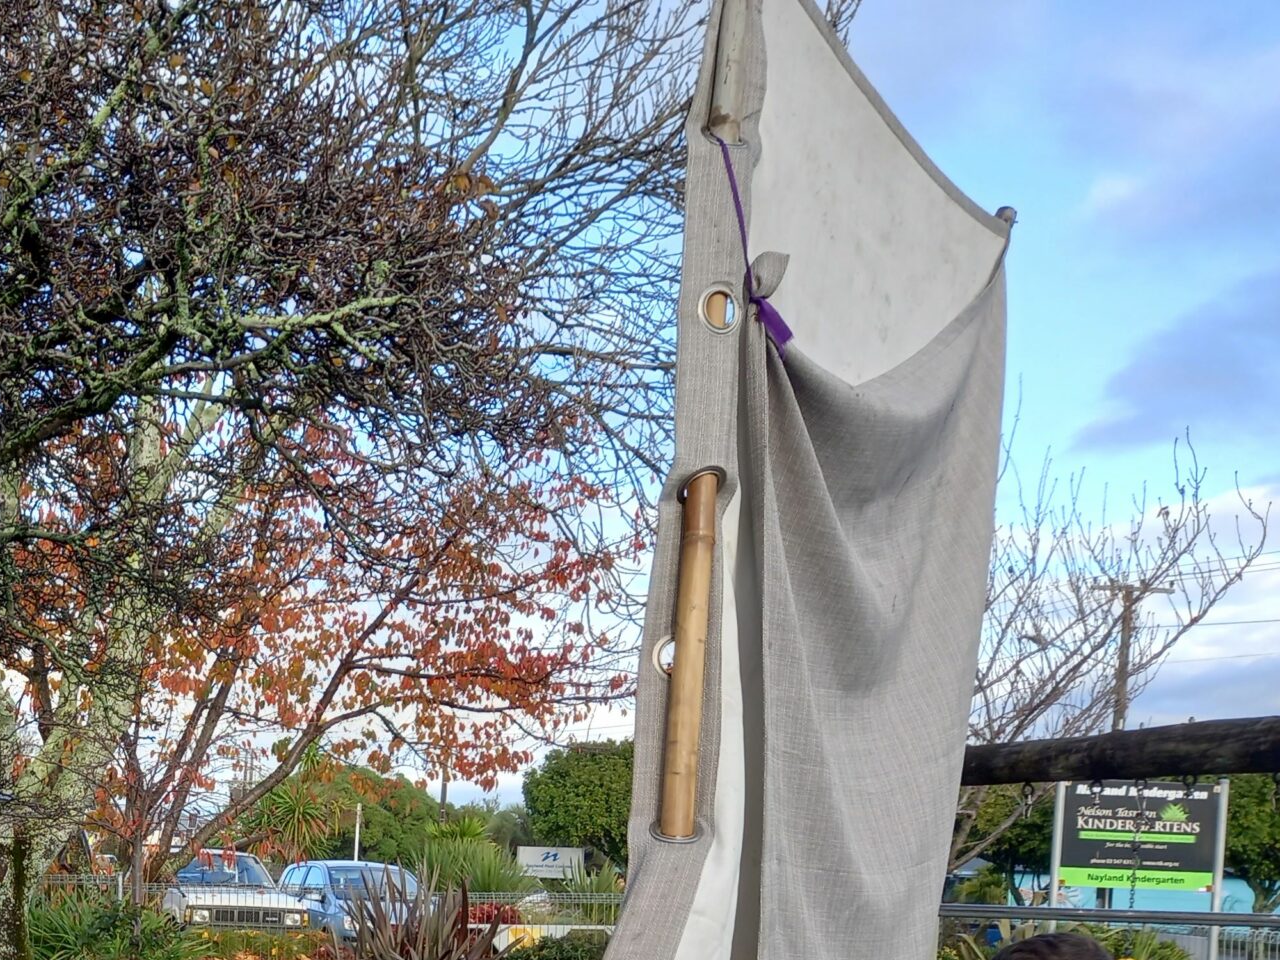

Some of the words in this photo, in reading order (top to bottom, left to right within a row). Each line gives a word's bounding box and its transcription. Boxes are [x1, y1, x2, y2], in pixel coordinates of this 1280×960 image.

[1076, 805, 1113, 817] Nelson
[1115, 806, 1157, 819] Tasan
[1076, 815, 1201, 834] KINDERRTENS
[1087, 873, 1125, 883] Nayland
